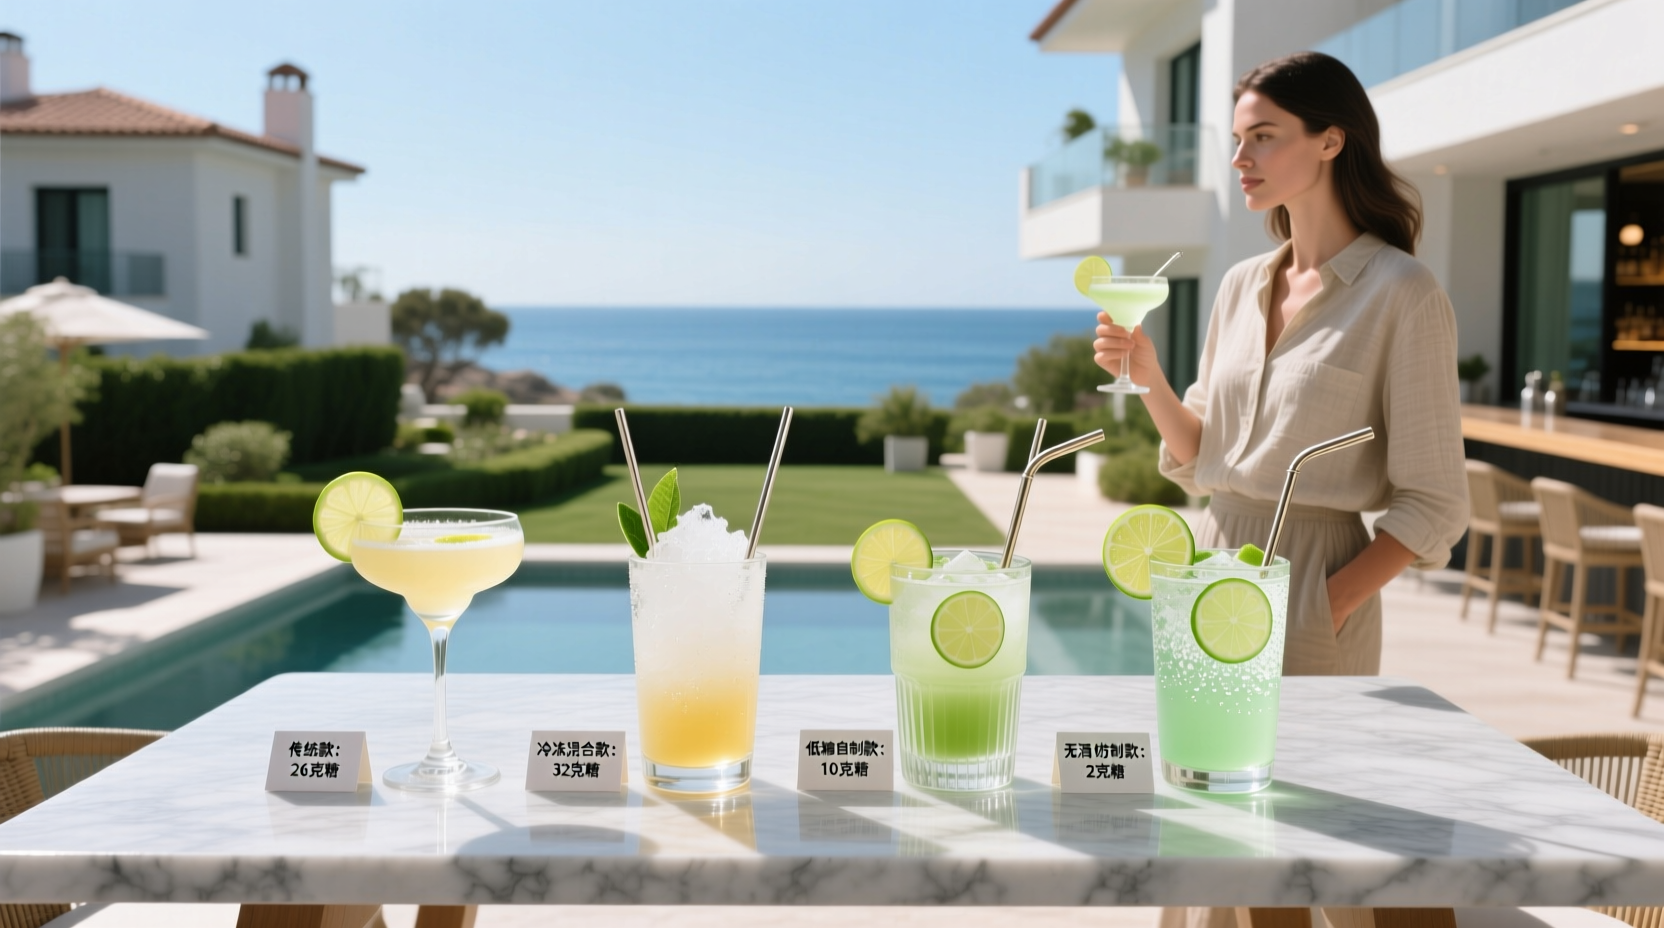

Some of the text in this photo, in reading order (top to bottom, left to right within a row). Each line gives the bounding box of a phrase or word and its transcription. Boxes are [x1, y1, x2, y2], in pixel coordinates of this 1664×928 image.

[290, 761, 341, 779] 26克糖
[820, 761, 869, 778] 10克糖
[1085, 763, 1125, 780] 2克糖
